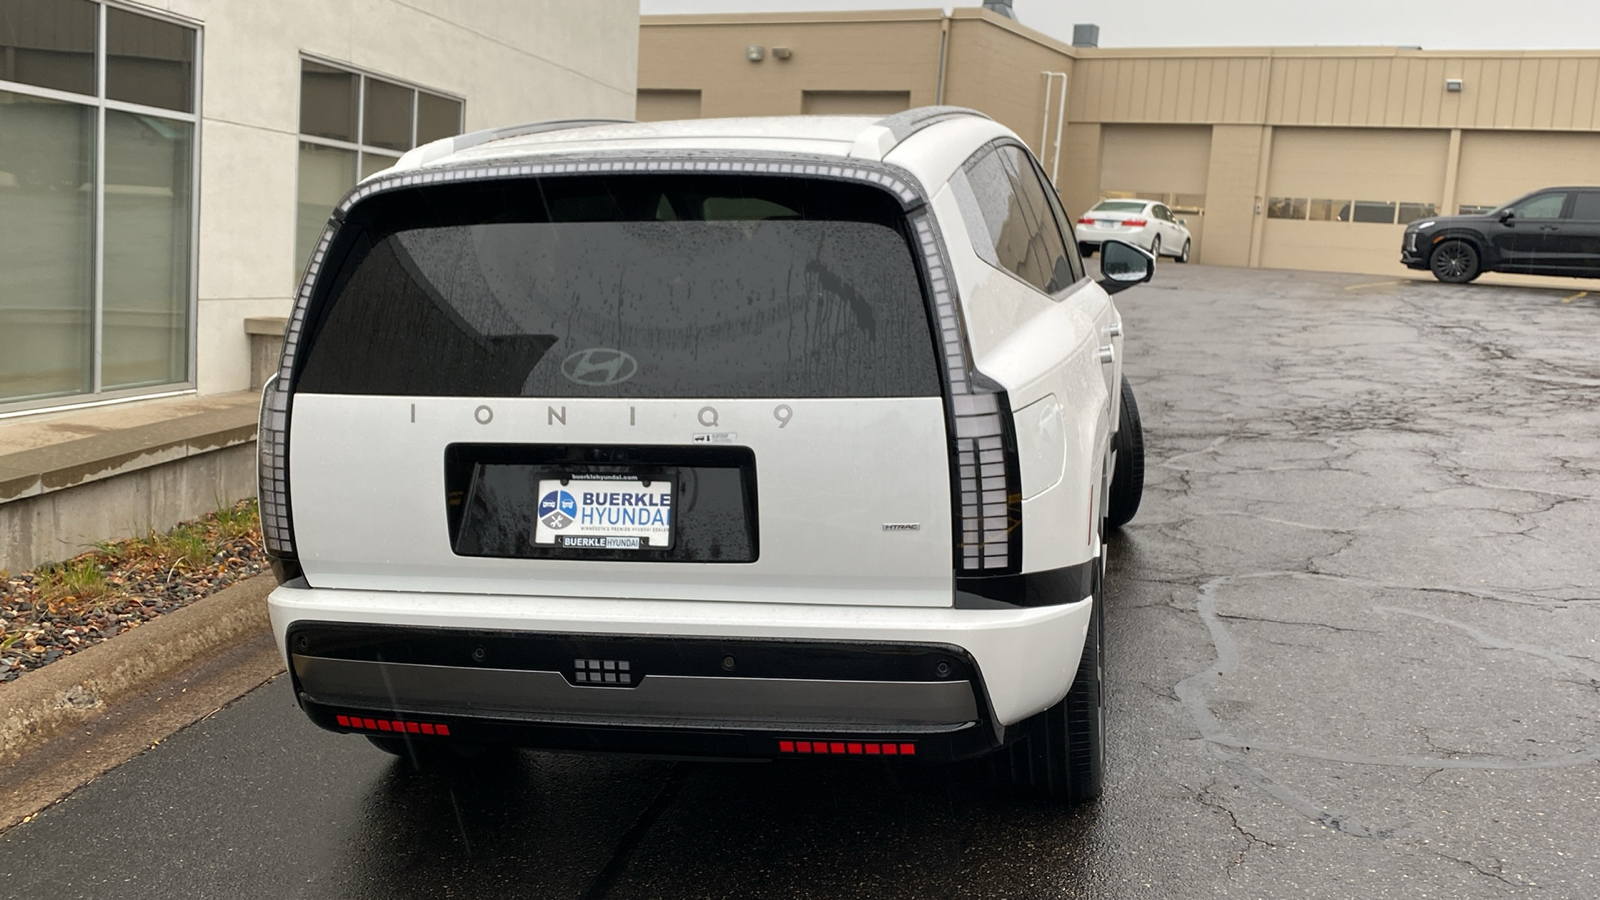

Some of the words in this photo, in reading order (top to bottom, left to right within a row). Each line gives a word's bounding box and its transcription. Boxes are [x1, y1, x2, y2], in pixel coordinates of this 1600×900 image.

[773, 404, 794, 429] 9
[582, 492, 671, 507] BUERKLE
[581, 507, 671, 526] HYUNDAI
[564, 537, 606, 547] BUERKLE
[607, 538, 639, 548] HYUNDAI
